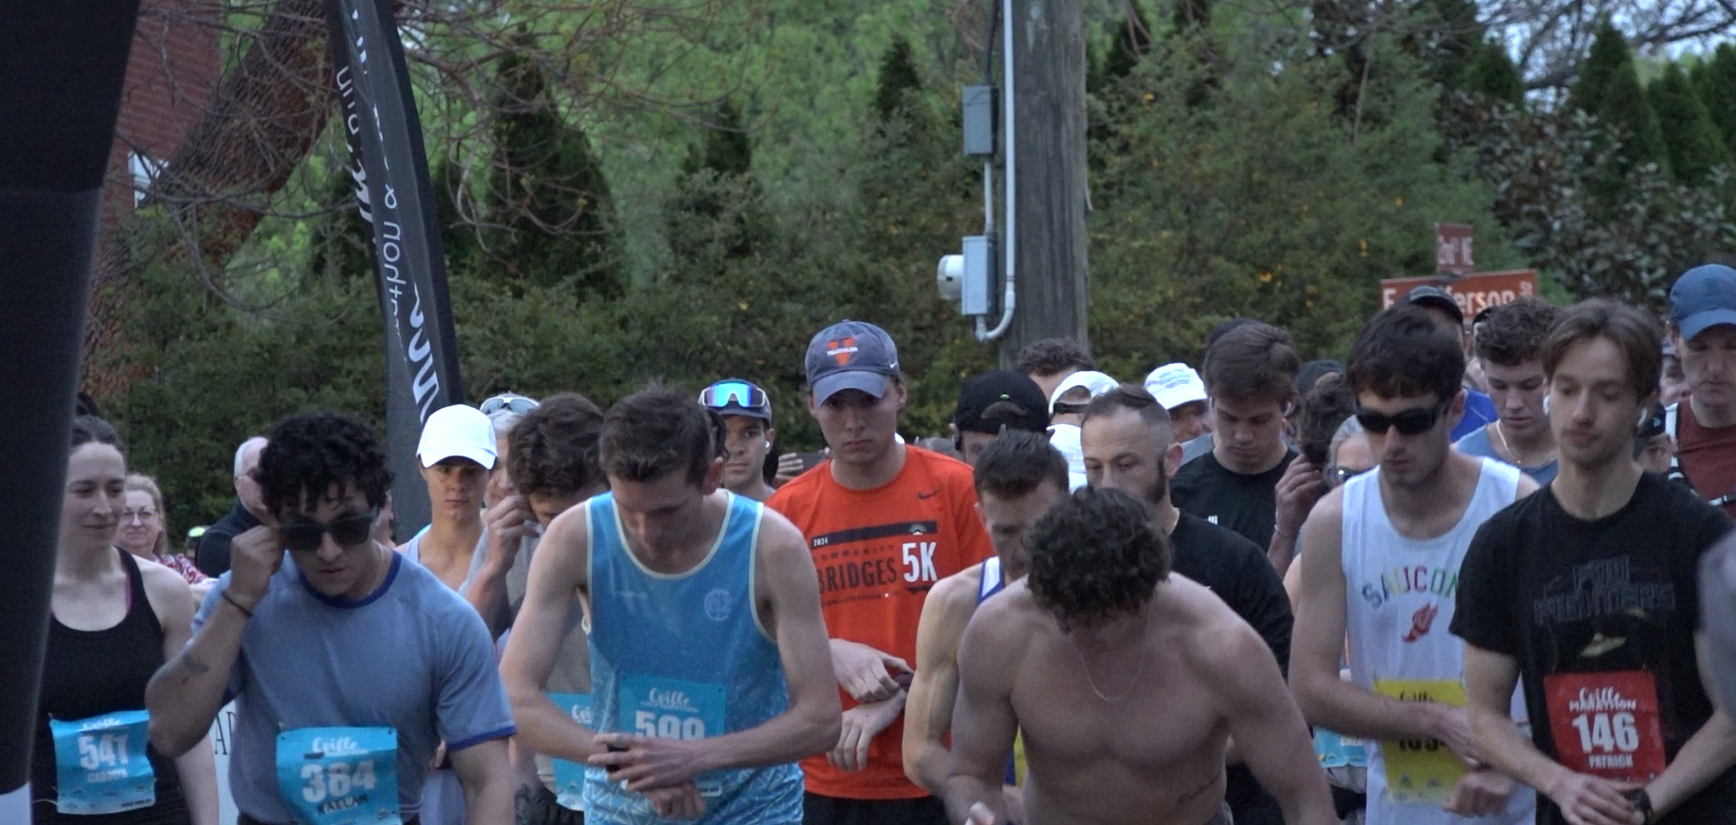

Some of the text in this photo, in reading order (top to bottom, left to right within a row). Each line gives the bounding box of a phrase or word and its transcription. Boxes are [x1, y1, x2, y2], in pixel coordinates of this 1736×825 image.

[1383, 287, 1397, 309] E
[813, 537, 828, 547] 2024
[817, 557, 897, 595] BRIDGES
[902, 542, 937, 582] 5K
[1362, 565, 1459, 609] SAUCON
[1572, 711, 1639, 754] 146
[1588, 753, 1634, 769] PATRICK
